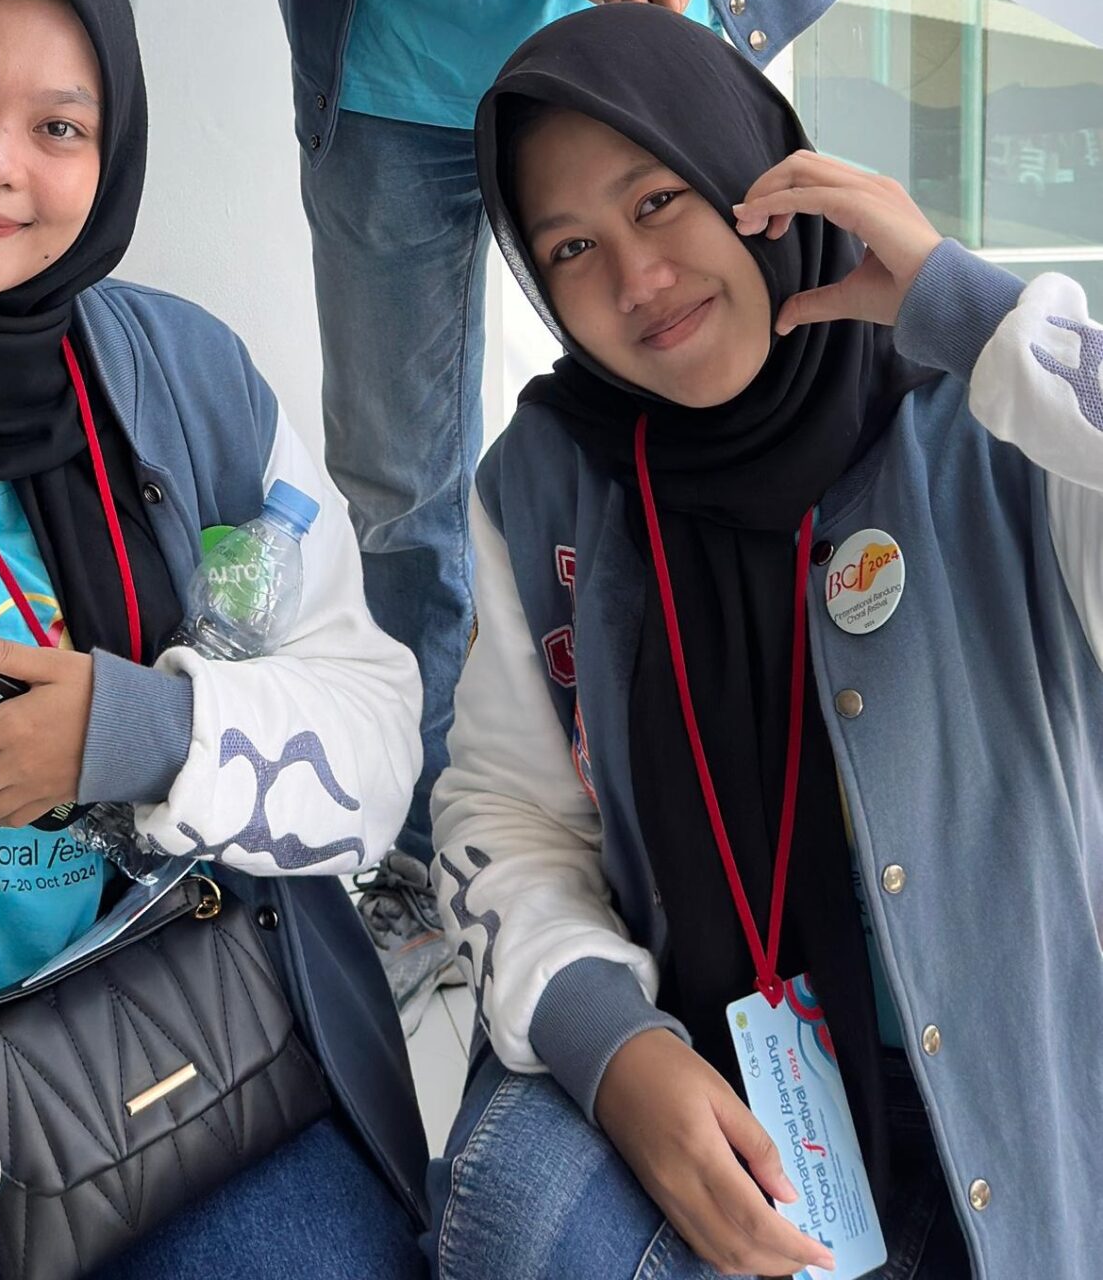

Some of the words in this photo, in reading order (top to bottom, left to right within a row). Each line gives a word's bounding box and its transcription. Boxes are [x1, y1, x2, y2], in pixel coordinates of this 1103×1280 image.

[868, 549, 899, 572] 2024
[846, 607, 866, 625] Choral
[36, 876, 60, 889] Oct
[62, 864, 96, 886] 2024
[765, 1034, 794, 1116] Bandung
[786, 1048, 802, 1081] 2024
[784, 1120, 822, 1232] International
[812, 1163, 837, 1224] Choral
